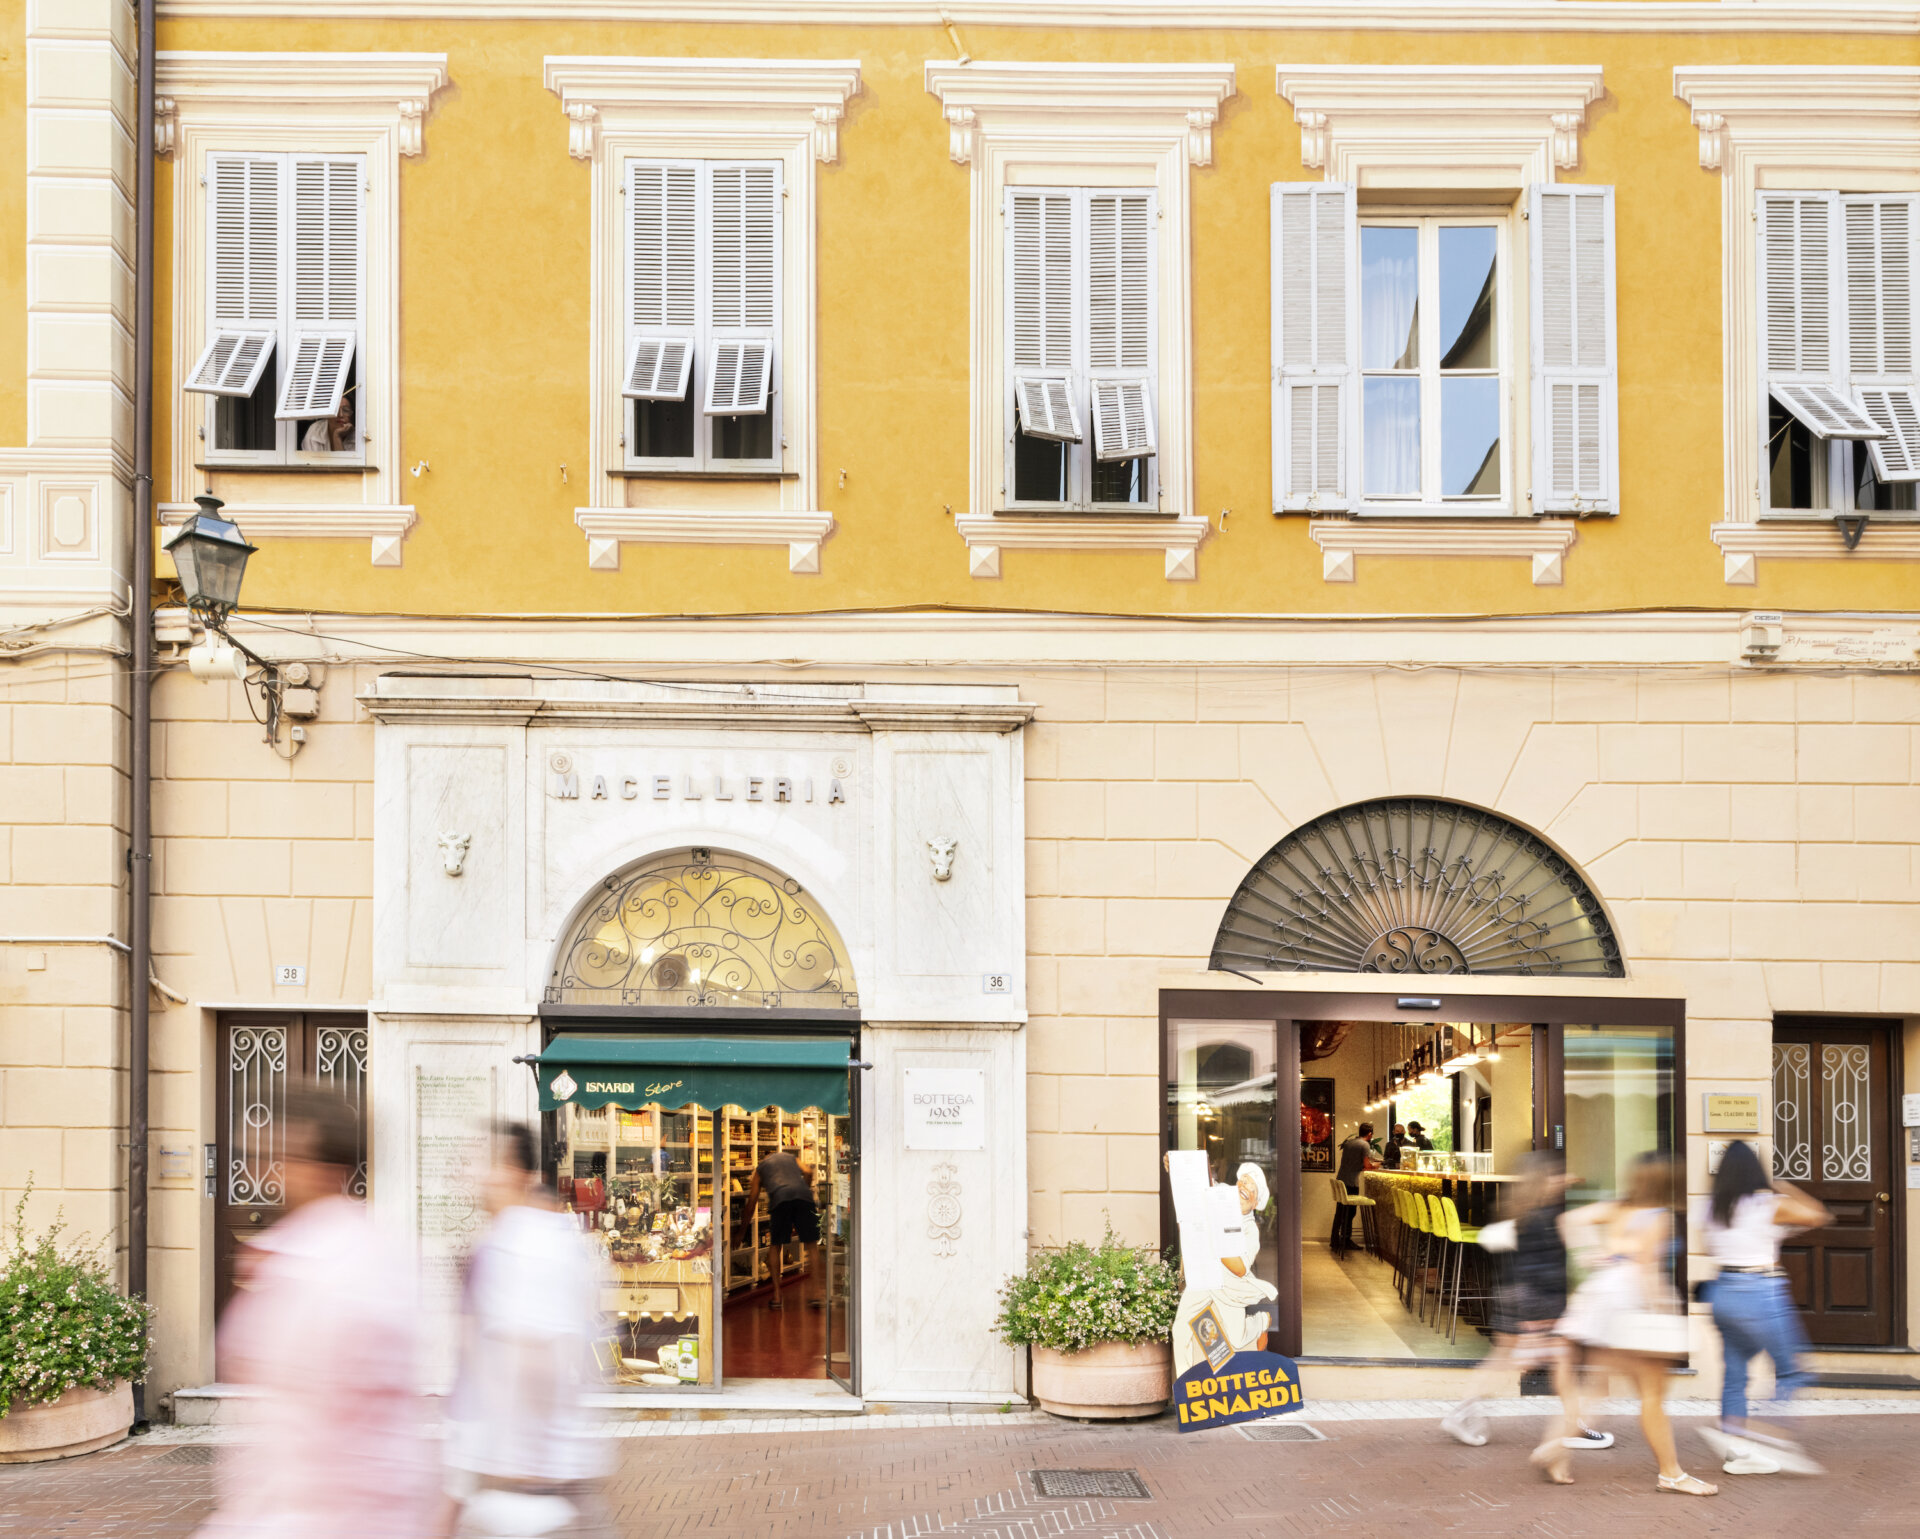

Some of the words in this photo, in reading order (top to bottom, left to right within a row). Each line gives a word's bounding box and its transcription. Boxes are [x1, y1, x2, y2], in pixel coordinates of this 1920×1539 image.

[556, 774, 846, 804] MACELLERIA
[284, 968, 297, 979] 38
[990, 976, 1003, 987] 36
[586, 1082, 635, 1093] ISNARDI
[645, 1080, 683, 1097] Store
[913, 1094, 974, 1105] BOTTEGA
[929, 1105, 961, 1118] 1908
[1185, 1367, 1290, 1398] BOTTEGA
[1178, 1383, 1300, 1424] ISNARDI
